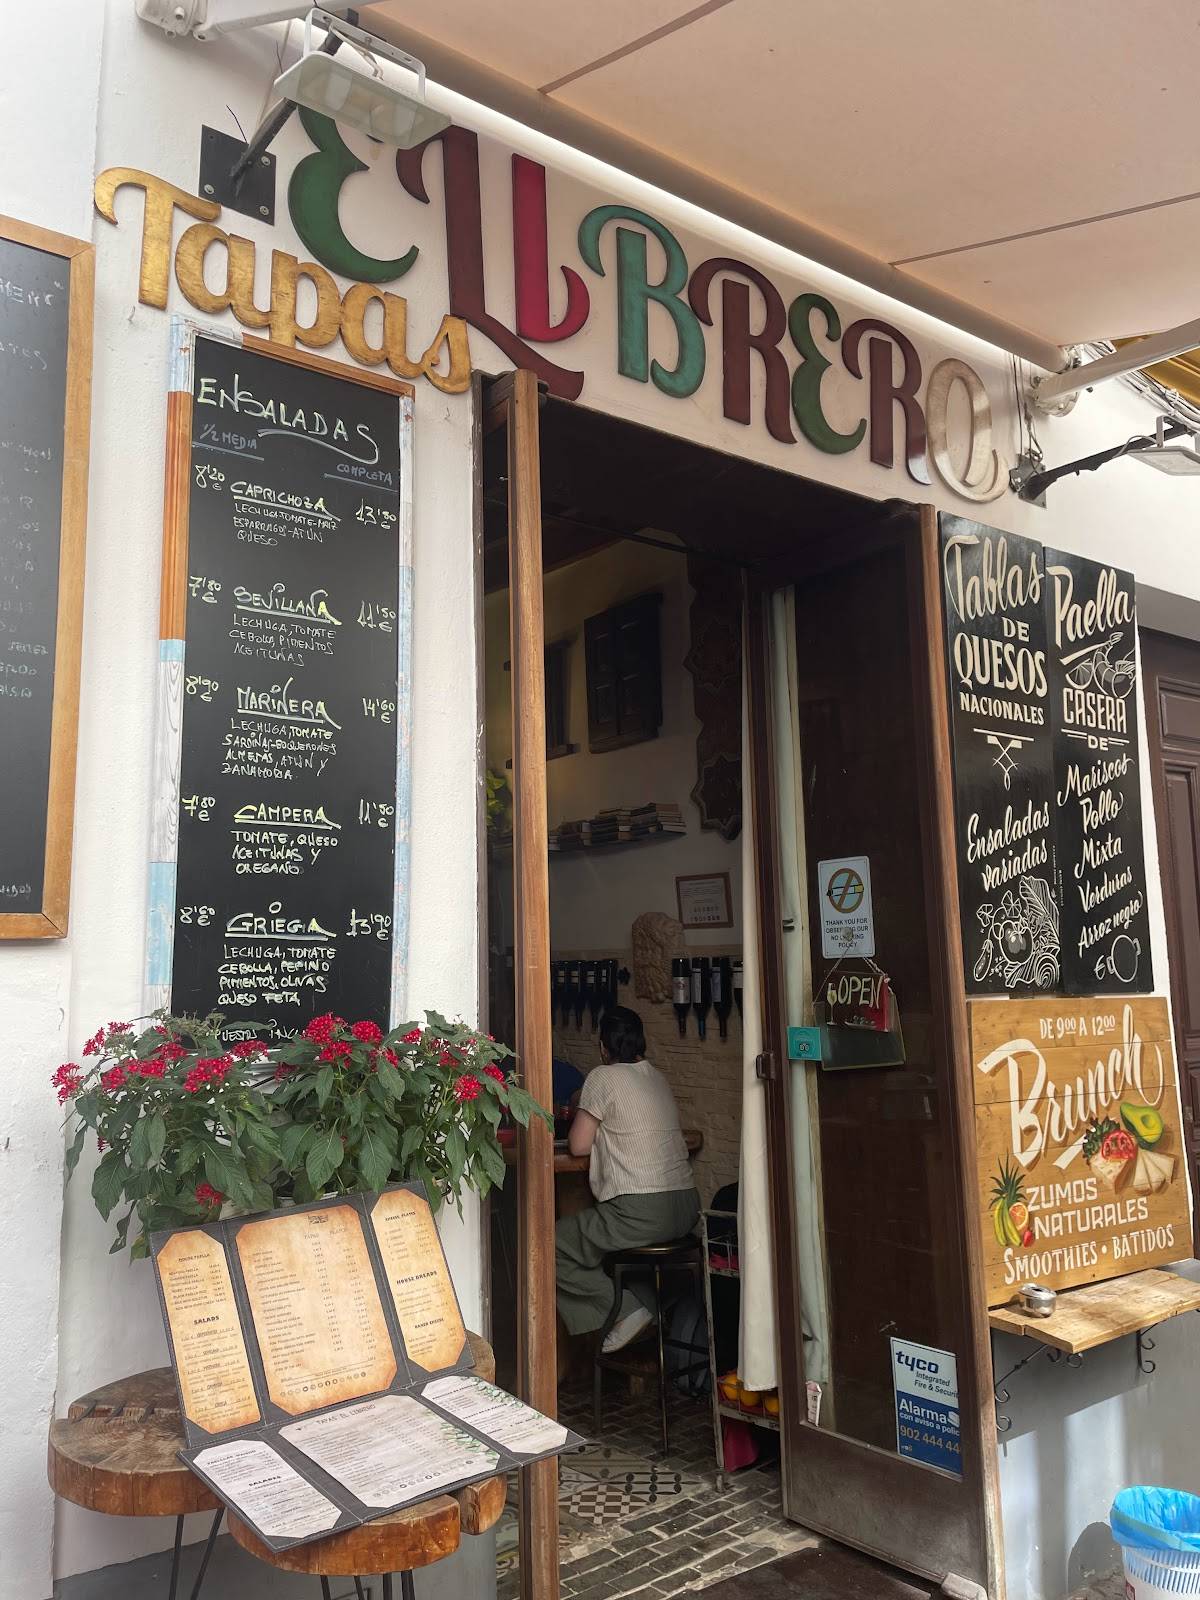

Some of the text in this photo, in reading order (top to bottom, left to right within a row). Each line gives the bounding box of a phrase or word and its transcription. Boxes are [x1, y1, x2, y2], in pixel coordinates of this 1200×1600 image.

[94, 166, 473, 394] Tapas
[197, 373, 379, 465] ENSALADAS
[222, 431, 257, 450] MEDIA
[336, 463, 394, 486] COMPLETA
[237, 529, 278, 546] QUESO
[943, 534, 1045, 624] Tablas
[234, 583, 342, 625] SEVILLANA
[1046, 565, 1136, 650] Paella
[290, 624, 337, 639] TOMATE
[1002, 616, 1030, 643] DE
[954, 632, 1049, 699] QUESOS
[236, 677, 342, 730] MARINERA
[959, 691, 1045, 726] NACIONALES
[1062, 687, 1128, 734] CASERA
[289, 725, 334, 740] TOMATE
[1087, 736, 1110, 751] DE
[280, 752, 314, 769] ATUN
[1057, 752, 1136, 807] Mariscos
[233, 802, 342, 830] CAMPERA
[1079, 791, 1124, 834] Pollo
[296, 832, 338, 847] QUESO
[967, 799, 1050, 864] Ensaladas
[235, 861, 300, 875] OREGANO
[311, 848, 321, 865] Y
[1074, 832, 1123, 879] Mixta
[1077, 865, 1133, 913] Verduras
[226, 902, 337, 938] GRIEGA
[844, 917, 856, 925] YOU
[1077, 890, 1143, 958] Arroz negro
[287, 945, 337, 960] TOMATE
[280, 959, 330, 973] PEPINO
[280, 973, 327, 993] OLIVAS
[836, 974, 884, 1010] OPEN
[217, 990, 257, 1007] QUESO
[1039, 1018, 1055, 1040] DE
[1079, 1016, 1088, 1037] A
[977, 1003, 1165, 1168] Brunch
[1026, 1177, 1098, 1213] ZUMOS
[1032, 1196, 1149, 1240] NATURALES
[1003, 1223, 1175, 1285] SMOOTHIES BATIDOS
[193, 1315, 220, 1325] SALADS
[895, 1350, 939, 1374] tyco
[914, 1379, 928, 1390] Fire
[928, 1383, 935, 1392] &
[915, 1371, 951, 1388] Integrated
[899, 1398, 948, 1424] Alarma
[899, 1411, 914, 1421] con
[914, 1416, 935, 1429] aviso
[899, 1425, 921, 1442] 902
[921, 1431, 944, 1450] 444
